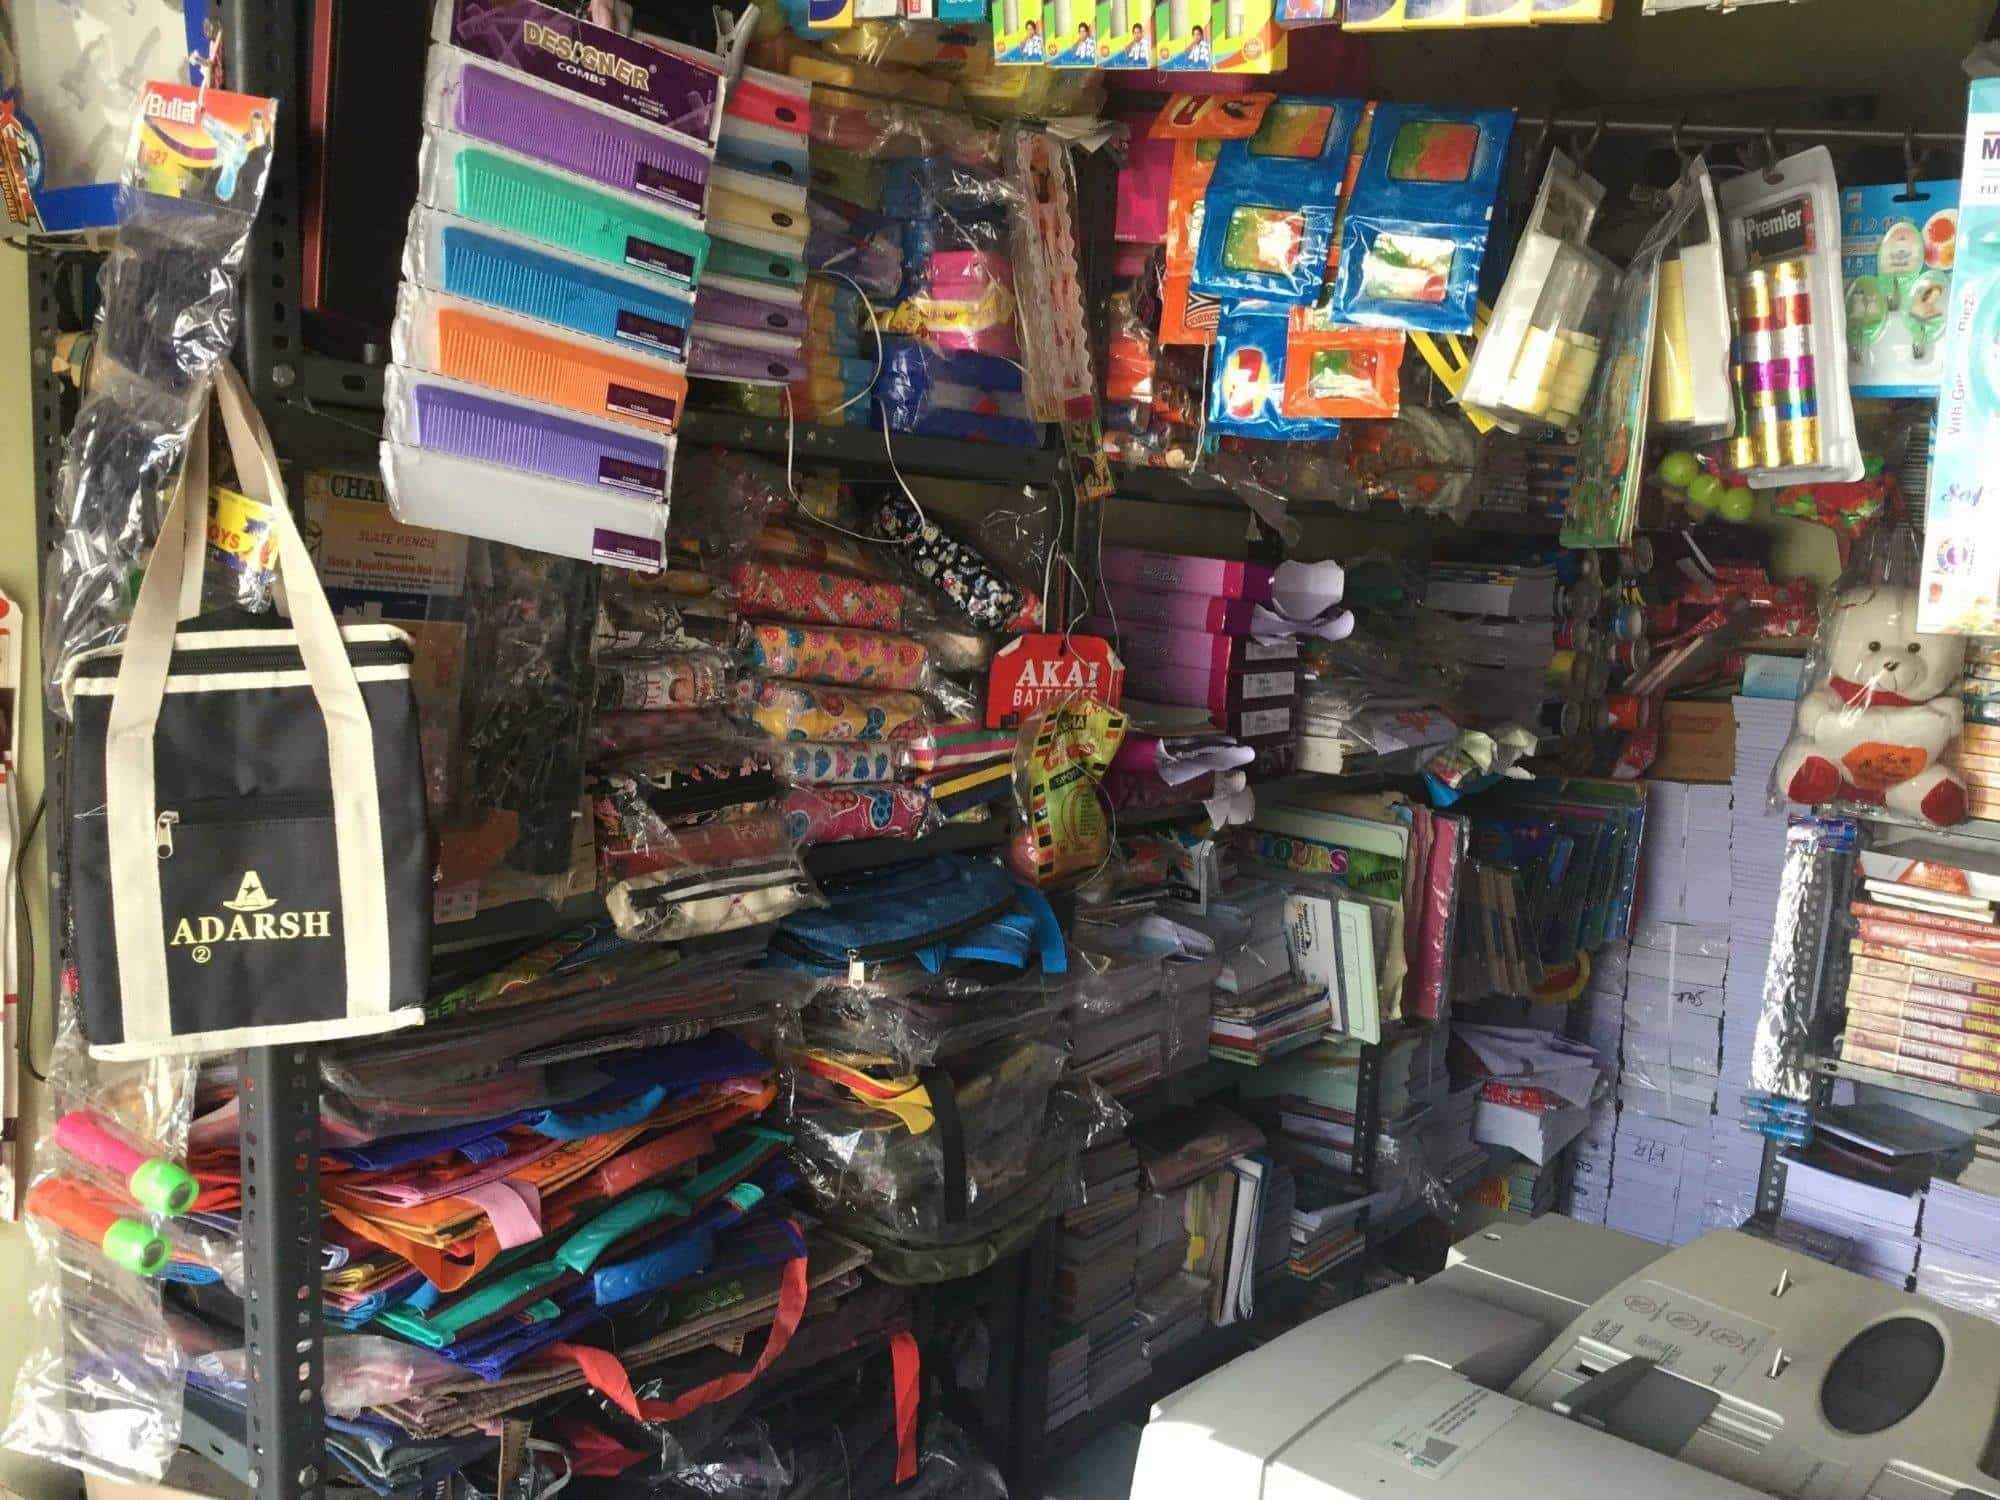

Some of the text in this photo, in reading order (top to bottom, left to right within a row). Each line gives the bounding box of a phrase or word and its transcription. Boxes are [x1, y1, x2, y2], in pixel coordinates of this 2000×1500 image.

[523, 20, 650, 92] DESIGNER
[556, 61, 608, 88] COMBS
[144, 92, 198, 125] Bullet
[1745, 207, 1802, 243] Premier
[331, 474, 385, 502] CHA
[207, 523, 241, 549] OYS
[1015, 658, 1101, 688] AKAI
[1013, 689, 1098, 706] BATTEES
[169, 911, 331, 946] ADARSH
